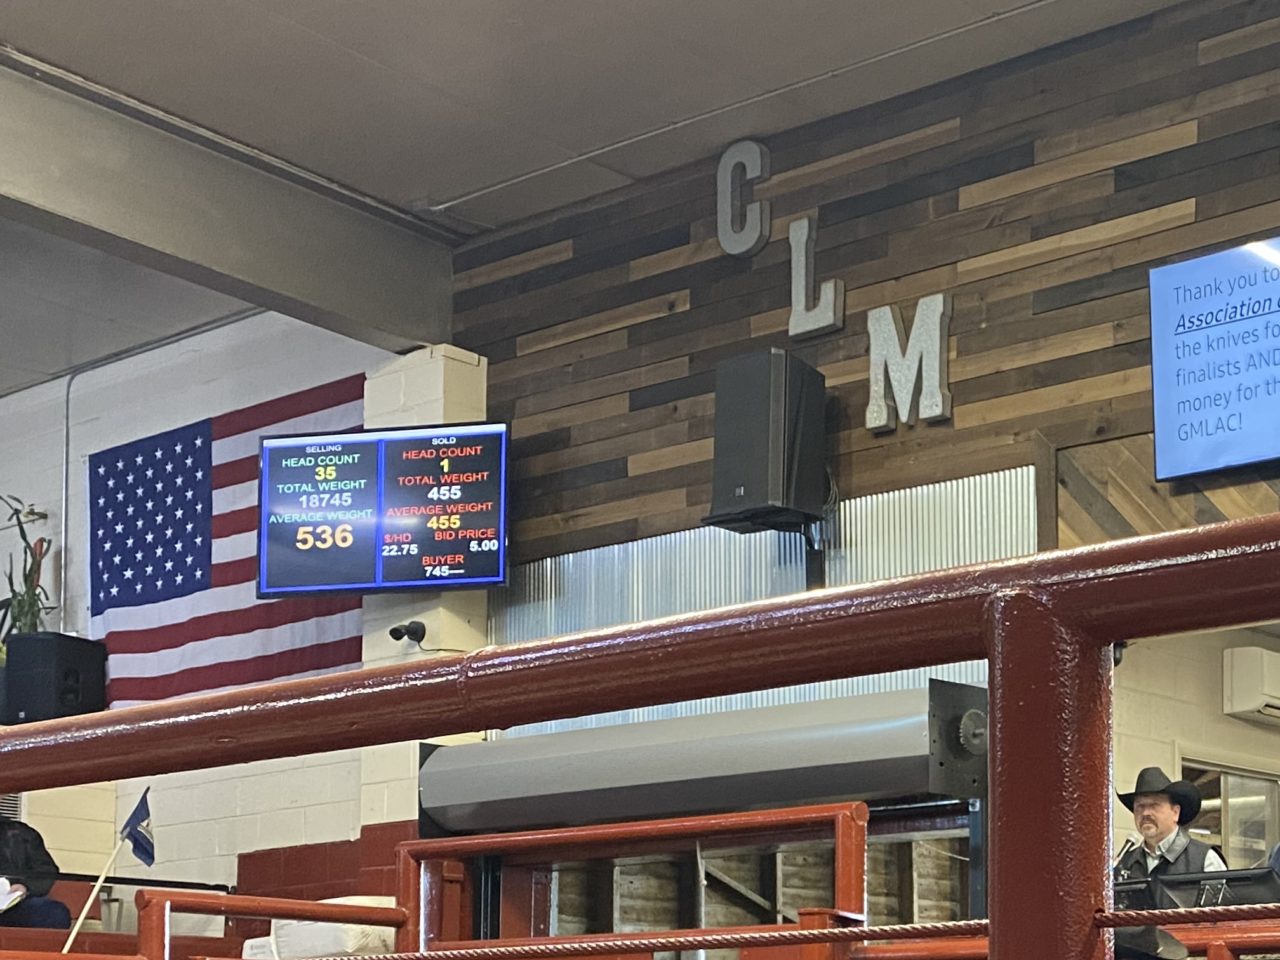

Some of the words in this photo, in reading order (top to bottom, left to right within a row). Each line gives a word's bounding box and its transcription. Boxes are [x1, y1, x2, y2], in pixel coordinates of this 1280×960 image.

[1173, 277, 1223, 304] Thank
[1228, 272, 1257, 297] you
[1263, 266, 1280, 283] to
[1175, 297, 1272, 333] Association
[1175, 340, 1201, 360] the
[1206, 330, 1259, 353] knives
[1176, 360, 1241, 388] finalists
[1177, 391, 1232, 415] money
[1237, 383, 1261, 403] for
[1178, 412, 1242, 441] GMLAC!
[305, 444, 342, 454] SELLING
[431, 436, 457, 446] SOLD
[281, 457, 315, 468] HEAD
[317, 453, 361, 465] COUNT
[402, 447, 436, 460] HEAD
[439, 445, 483, 458] COUNT
[314, 465, 337, 481] 35
[440, 458, 449, 473] 1
[276, 483, 316, 494] TOTAL
[318, 479, 367, 491] WEIGHT
[397, 475, 437, 486] TOTAL
[440, 471, 490, 484] WEIGHT
[298, 492, 353, 509] 18745
[427, 485, 462, 501] 455
[269, 512, 323, 524] AVERAGE
[327, 508, 373, 520] WEIGHT
[386, 504, 444, 517] AVERAGE
[446, 501, 494, 513] WEIGHT
[426, 514, 461, 530] 455
[295, 523, 354, 550] 536
[383, 532, 412, 544] $/HD
[434, 530, 456, 541] BID
[458, 527, 496, 540] PRICE
[381, 543, 419, 556] 22.75
[469, 539, 499, 552] 5.00
[421, 554, 465, 566] BUYER
